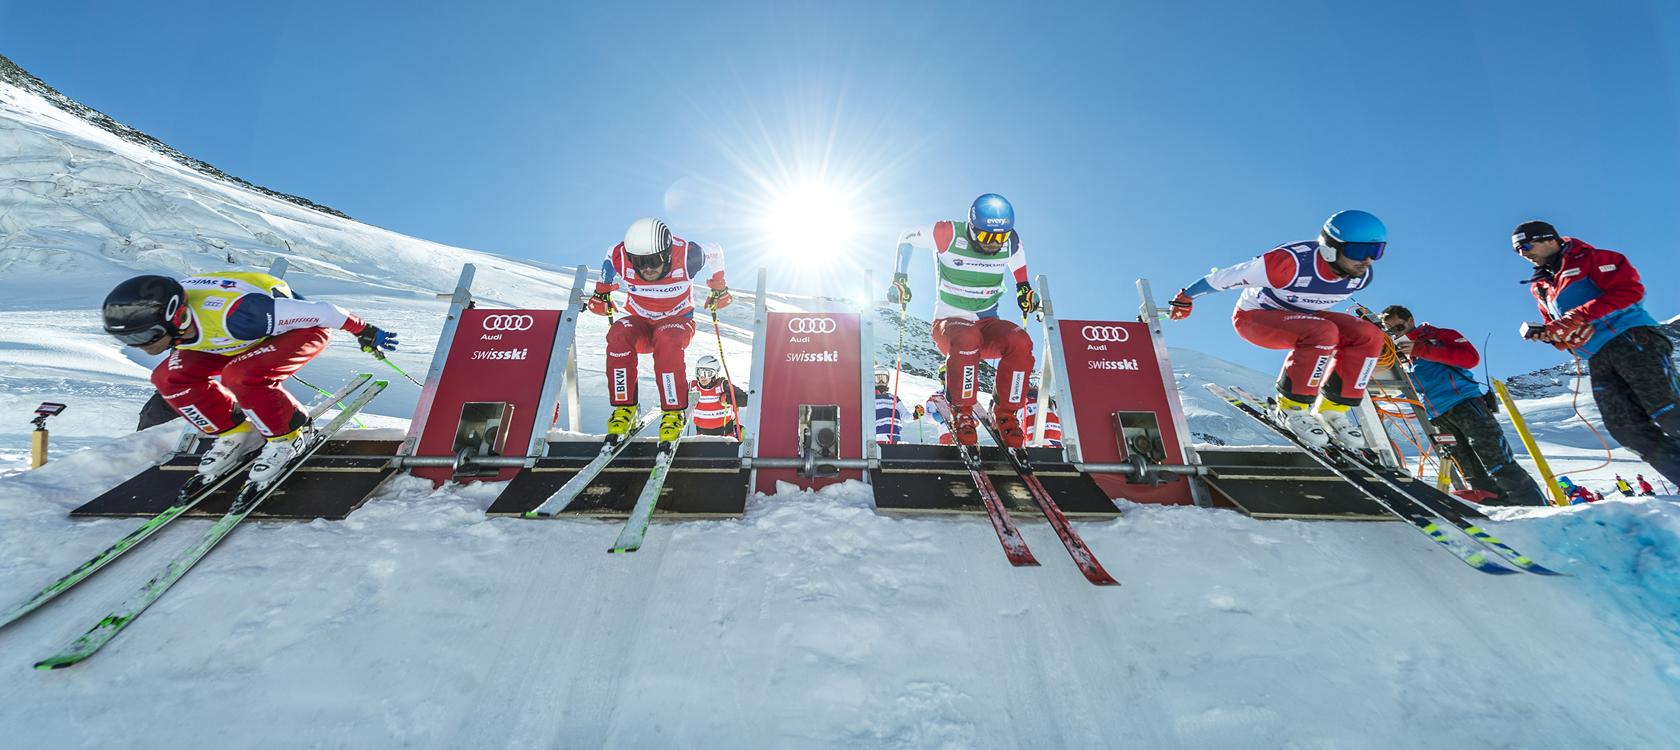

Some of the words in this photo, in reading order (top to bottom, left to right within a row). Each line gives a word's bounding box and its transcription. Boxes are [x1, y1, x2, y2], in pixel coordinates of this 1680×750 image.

[471, 348, 528, 360] swissski
[785, 350, 839, 362] swissski
[1087, 358, 1139, 371] swissski
[615, 369, 625, 392] BKW
[964, 367, 974, 390] BKW
[182, 406, 208, 427] BKW
